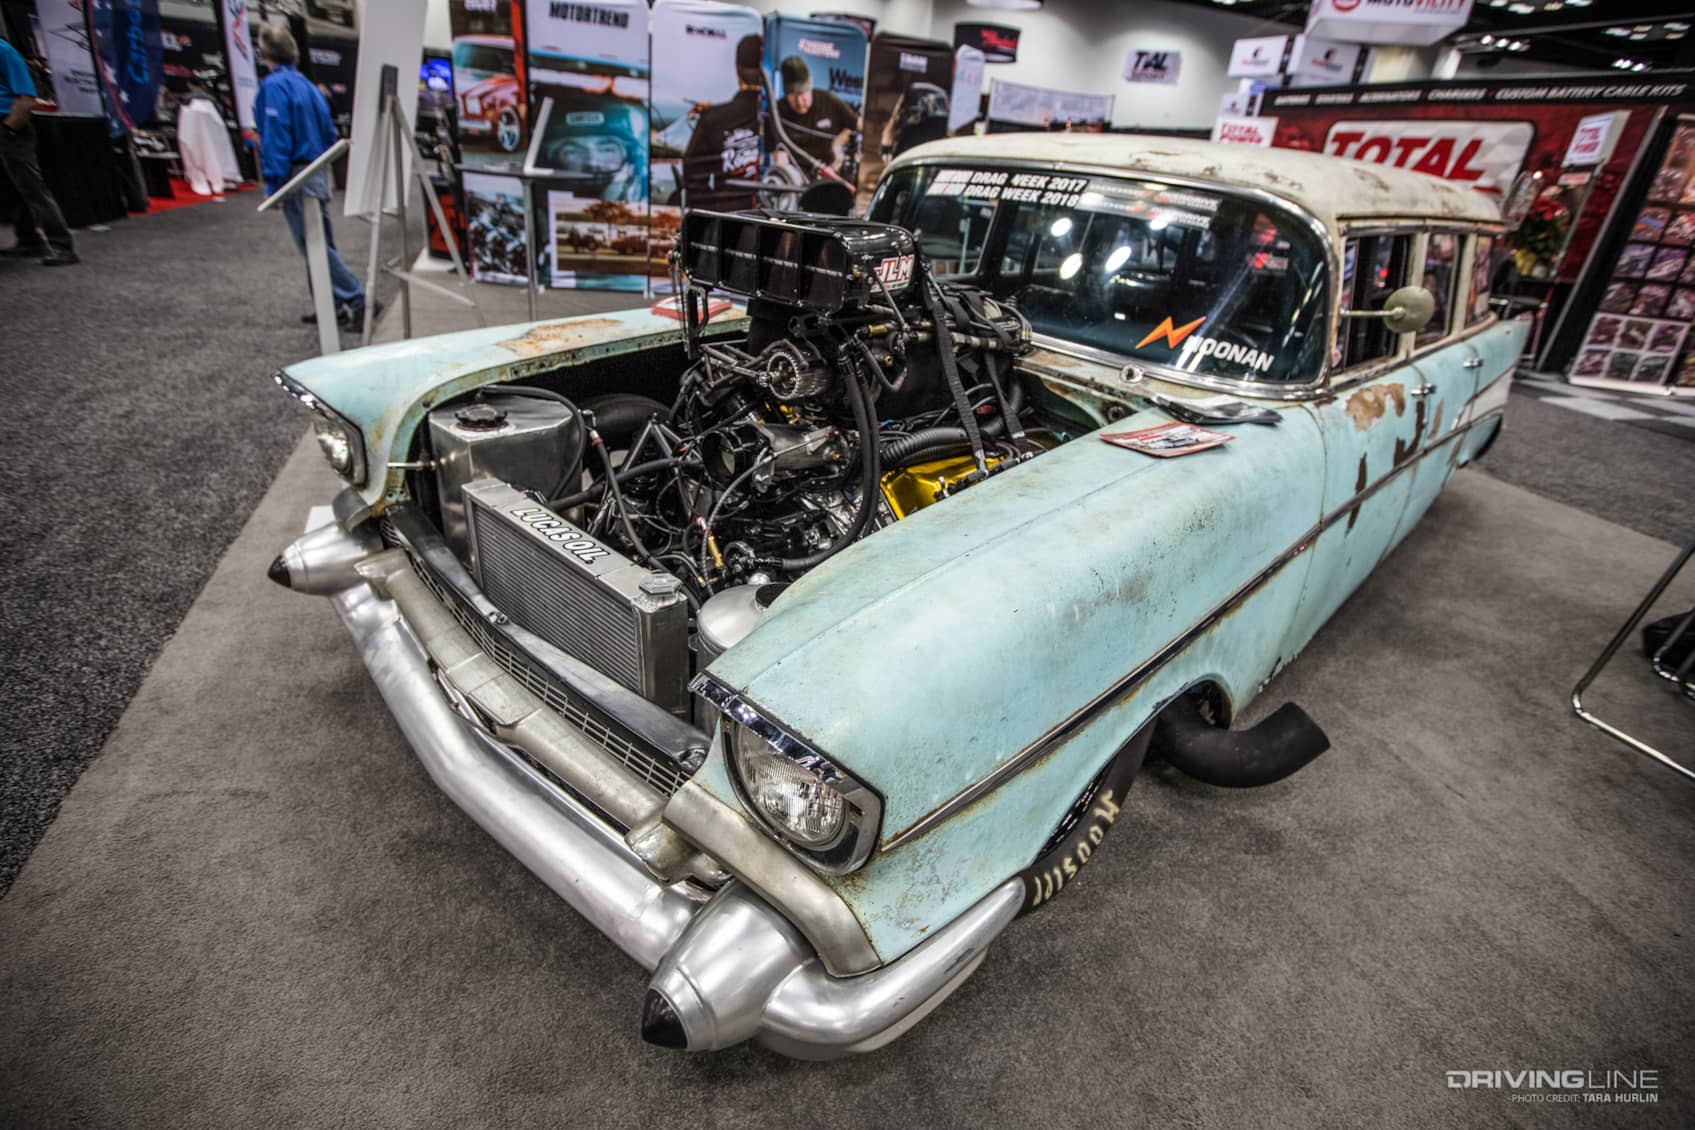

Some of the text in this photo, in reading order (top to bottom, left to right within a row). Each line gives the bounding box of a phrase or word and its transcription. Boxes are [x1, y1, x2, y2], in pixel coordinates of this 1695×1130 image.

[549, 4, 630, 28] MOTORTREND
[1495, 87, 1549, 100] CUSTOM
[1547, 86, 1604, 99] BATTERY
[1602, 84, 1650, 98] CABLE
[1648, 83, 1688, 97] KITS
[1331, 132, 1486, 181] TOTAL
[970, 171, 1009, 185] DRAG
[1048, 176, 1088, 192] 2017
[963, 184, 1003, 198] DRAG
[1001, 187, 1042, 203] WEEK
[1040, 191, 1080, 207] 2018
[873, 254, 915, 283] JLM
[510, 508, 611, 564] LUCAS OIL
